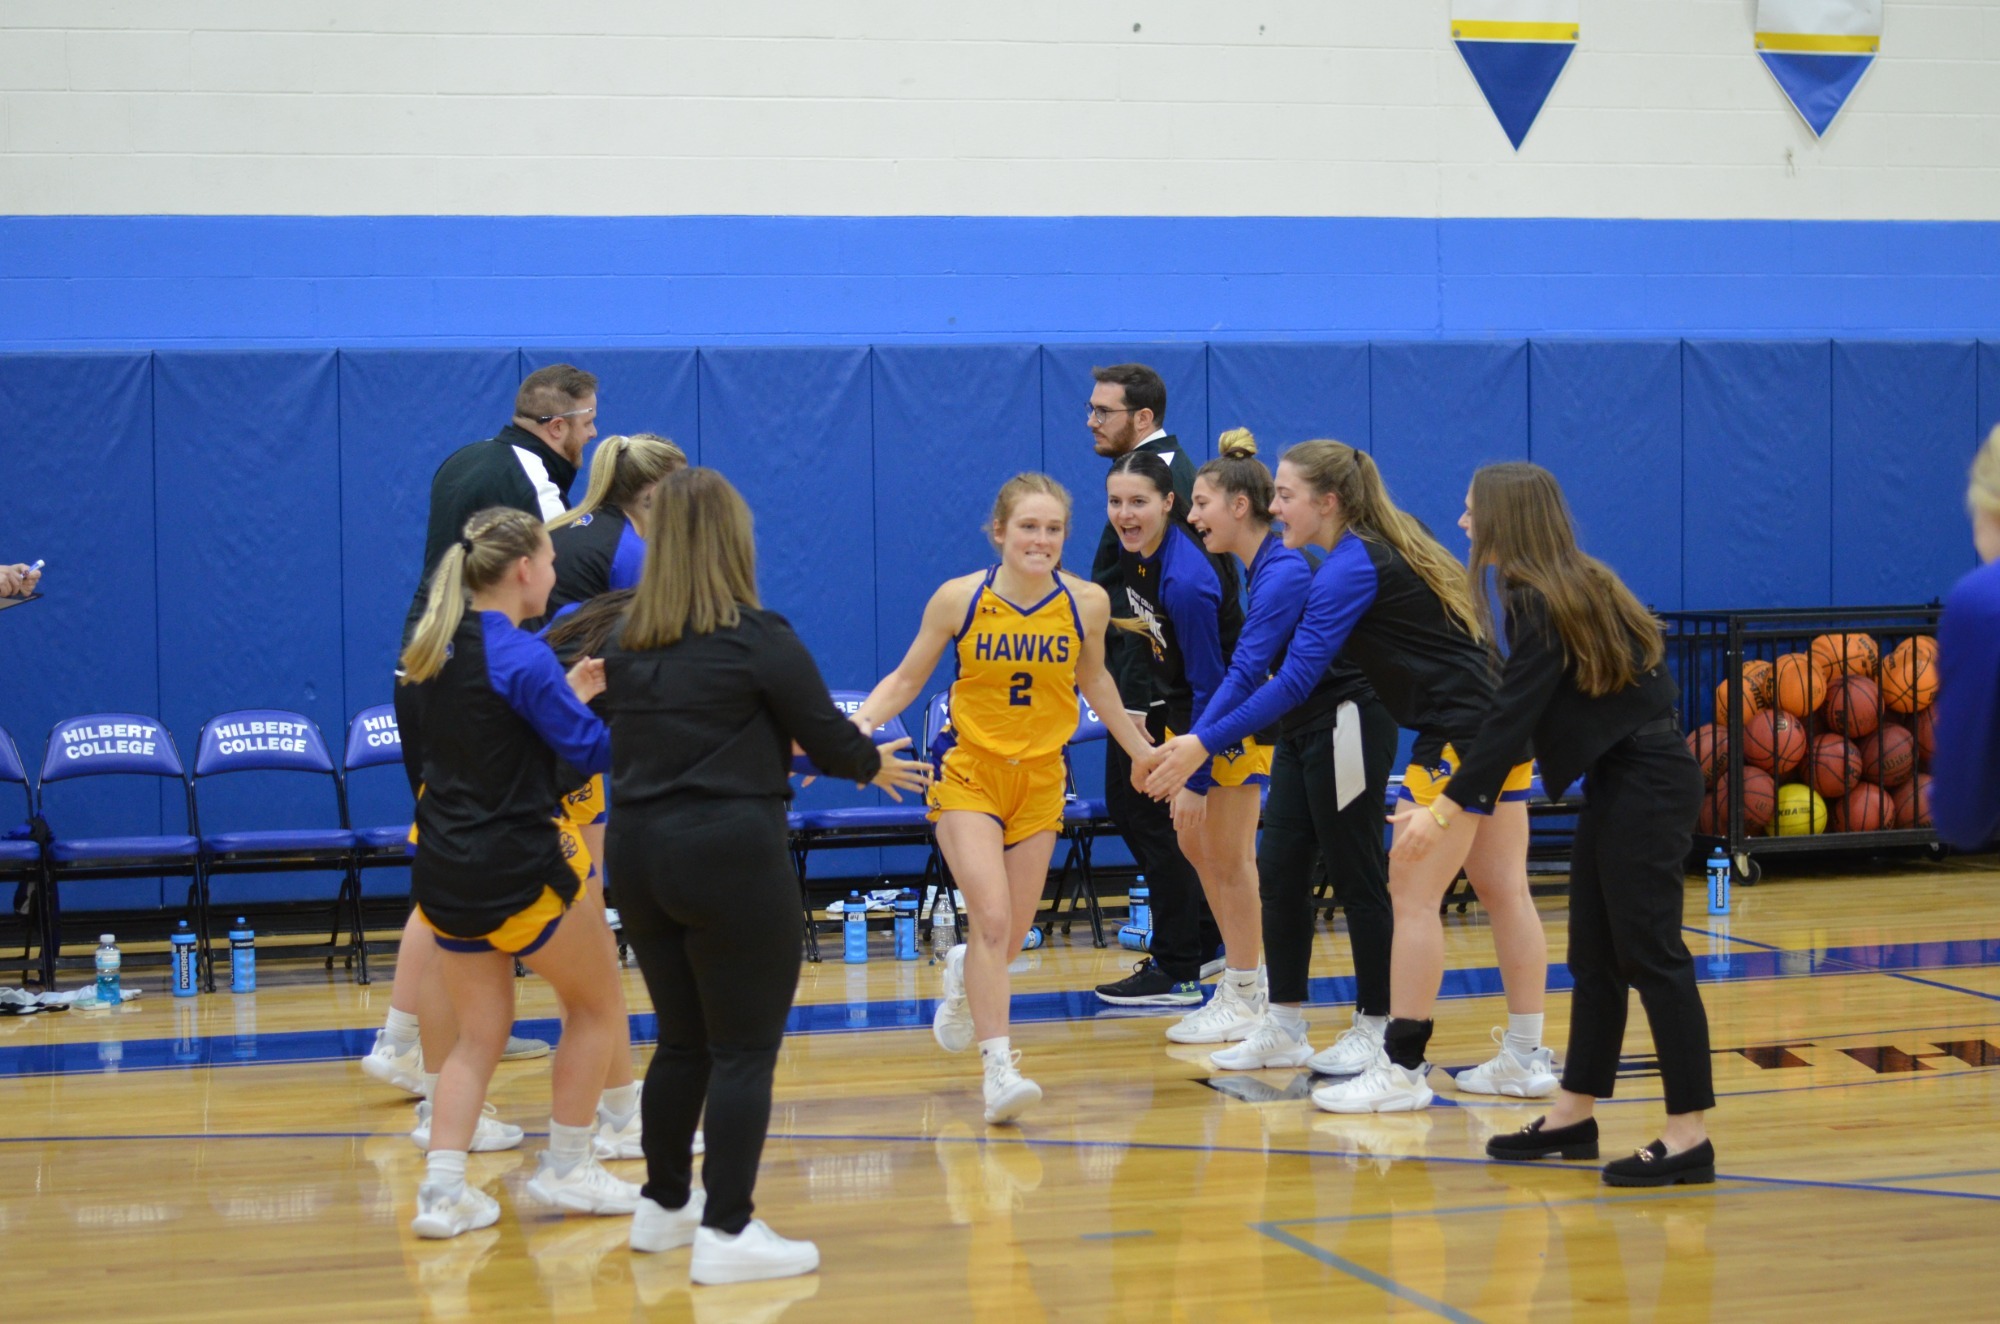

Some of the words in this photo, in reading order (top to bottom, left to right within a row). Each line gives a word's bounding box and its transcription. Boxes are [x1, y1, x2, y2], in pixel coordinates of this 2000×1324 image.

[975, 633, 1070, 663] HAWKS
[1009, 672, 1033, 707] 2
[62, 724, 157, 743] HILBERT
[214, 721, 308, 739] HILBERT
[66, 740, 156, 759] COLLEGE
[219, 737, 307, 755] COLLEGE
[180, 944, 189, 989] POWERADE
